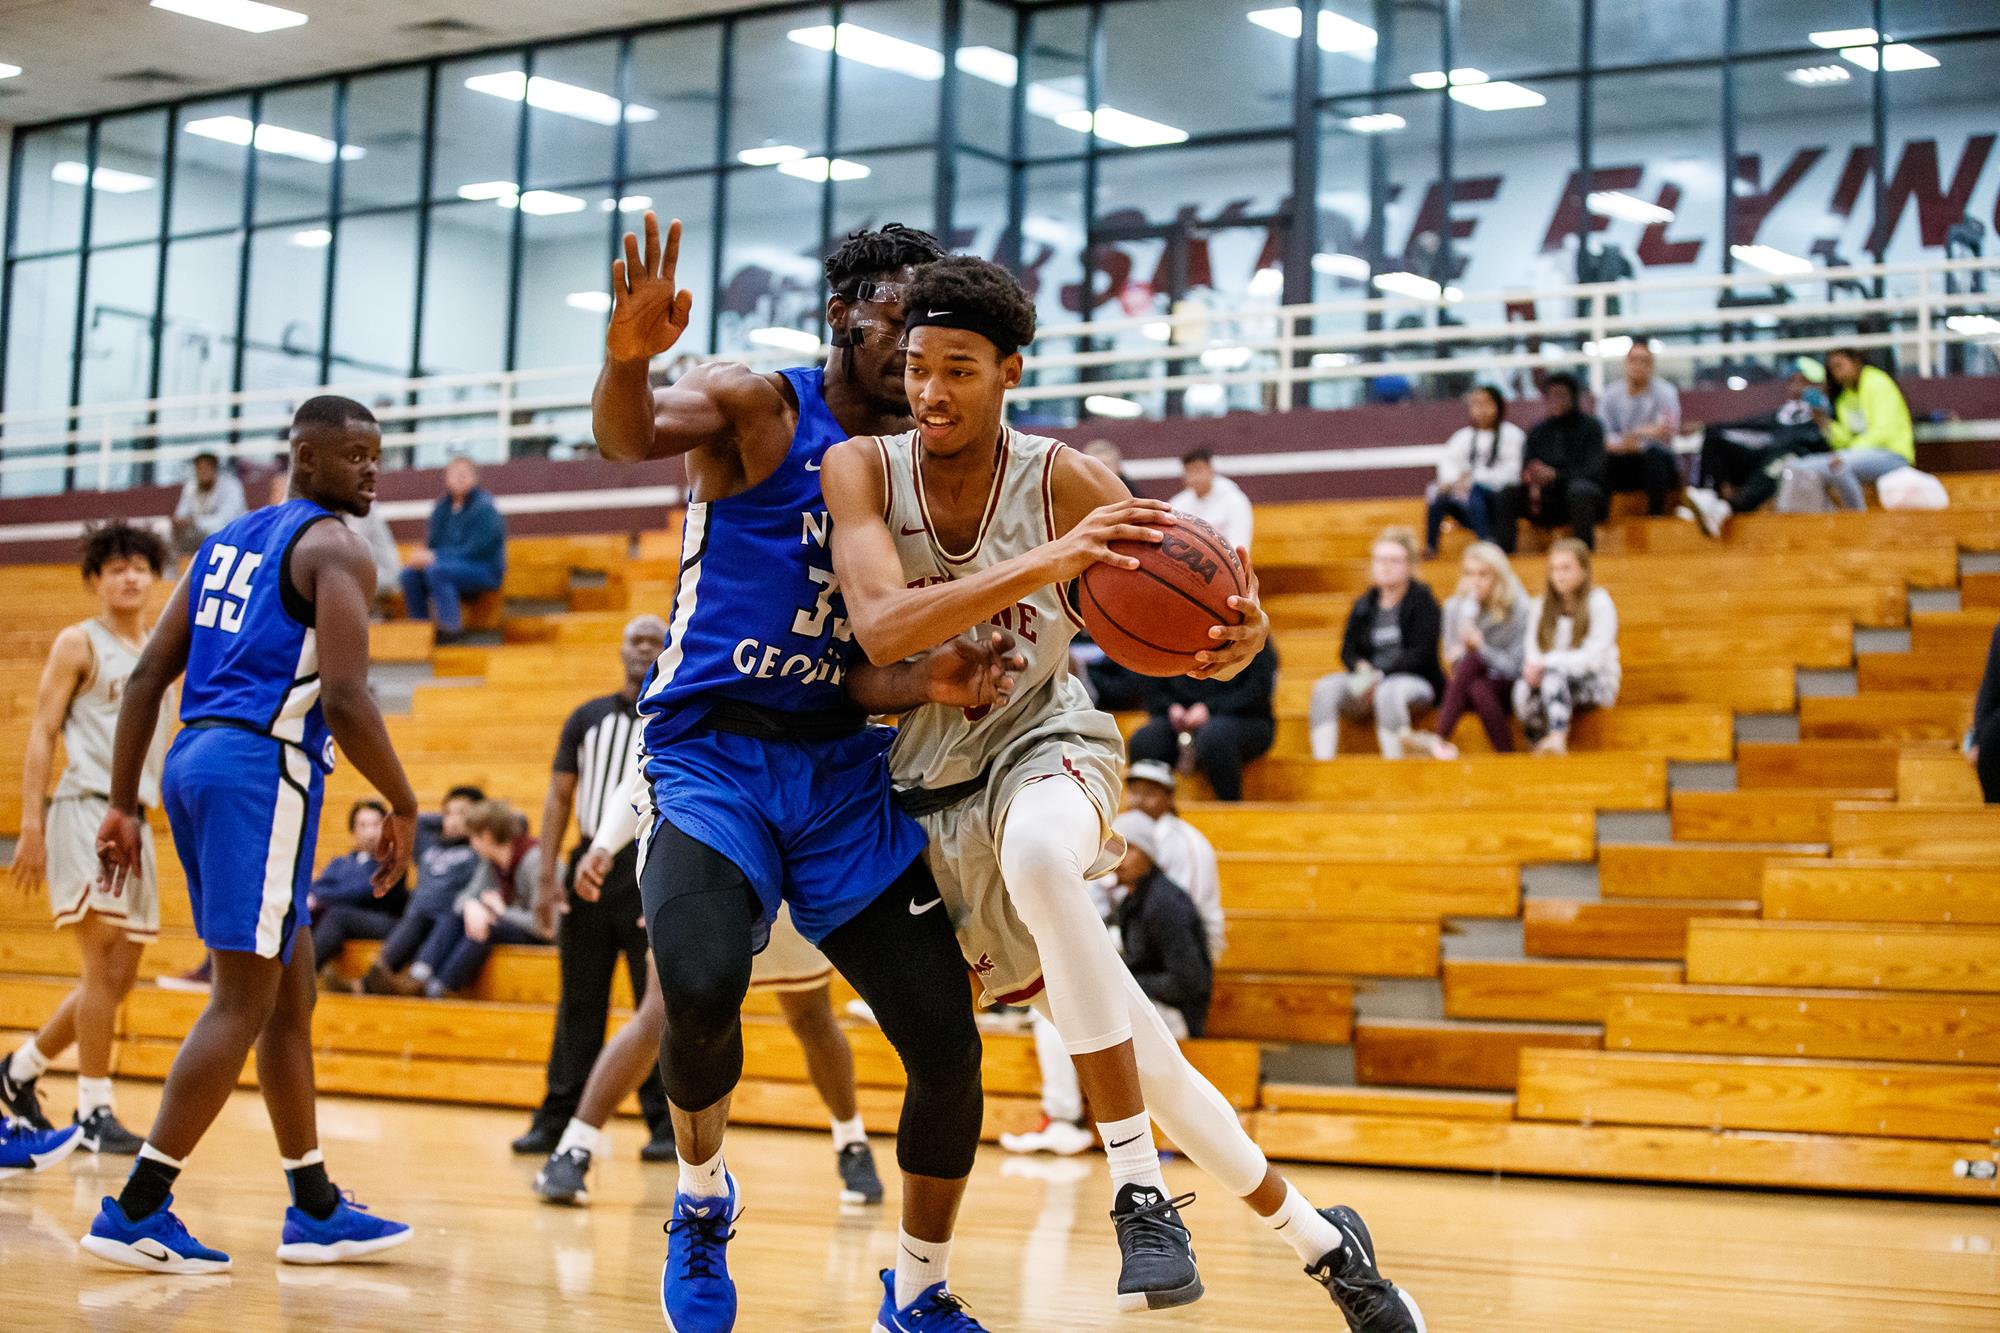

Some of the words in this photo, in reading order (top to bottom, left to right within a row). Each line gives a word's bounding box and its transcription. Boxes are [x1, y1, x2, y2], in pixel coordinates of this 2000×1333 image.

[1540, 134, 2000, 267] FLYIN
[195, 543, 263, 634] 25
[1161, 531, 1218, 585] CAA
